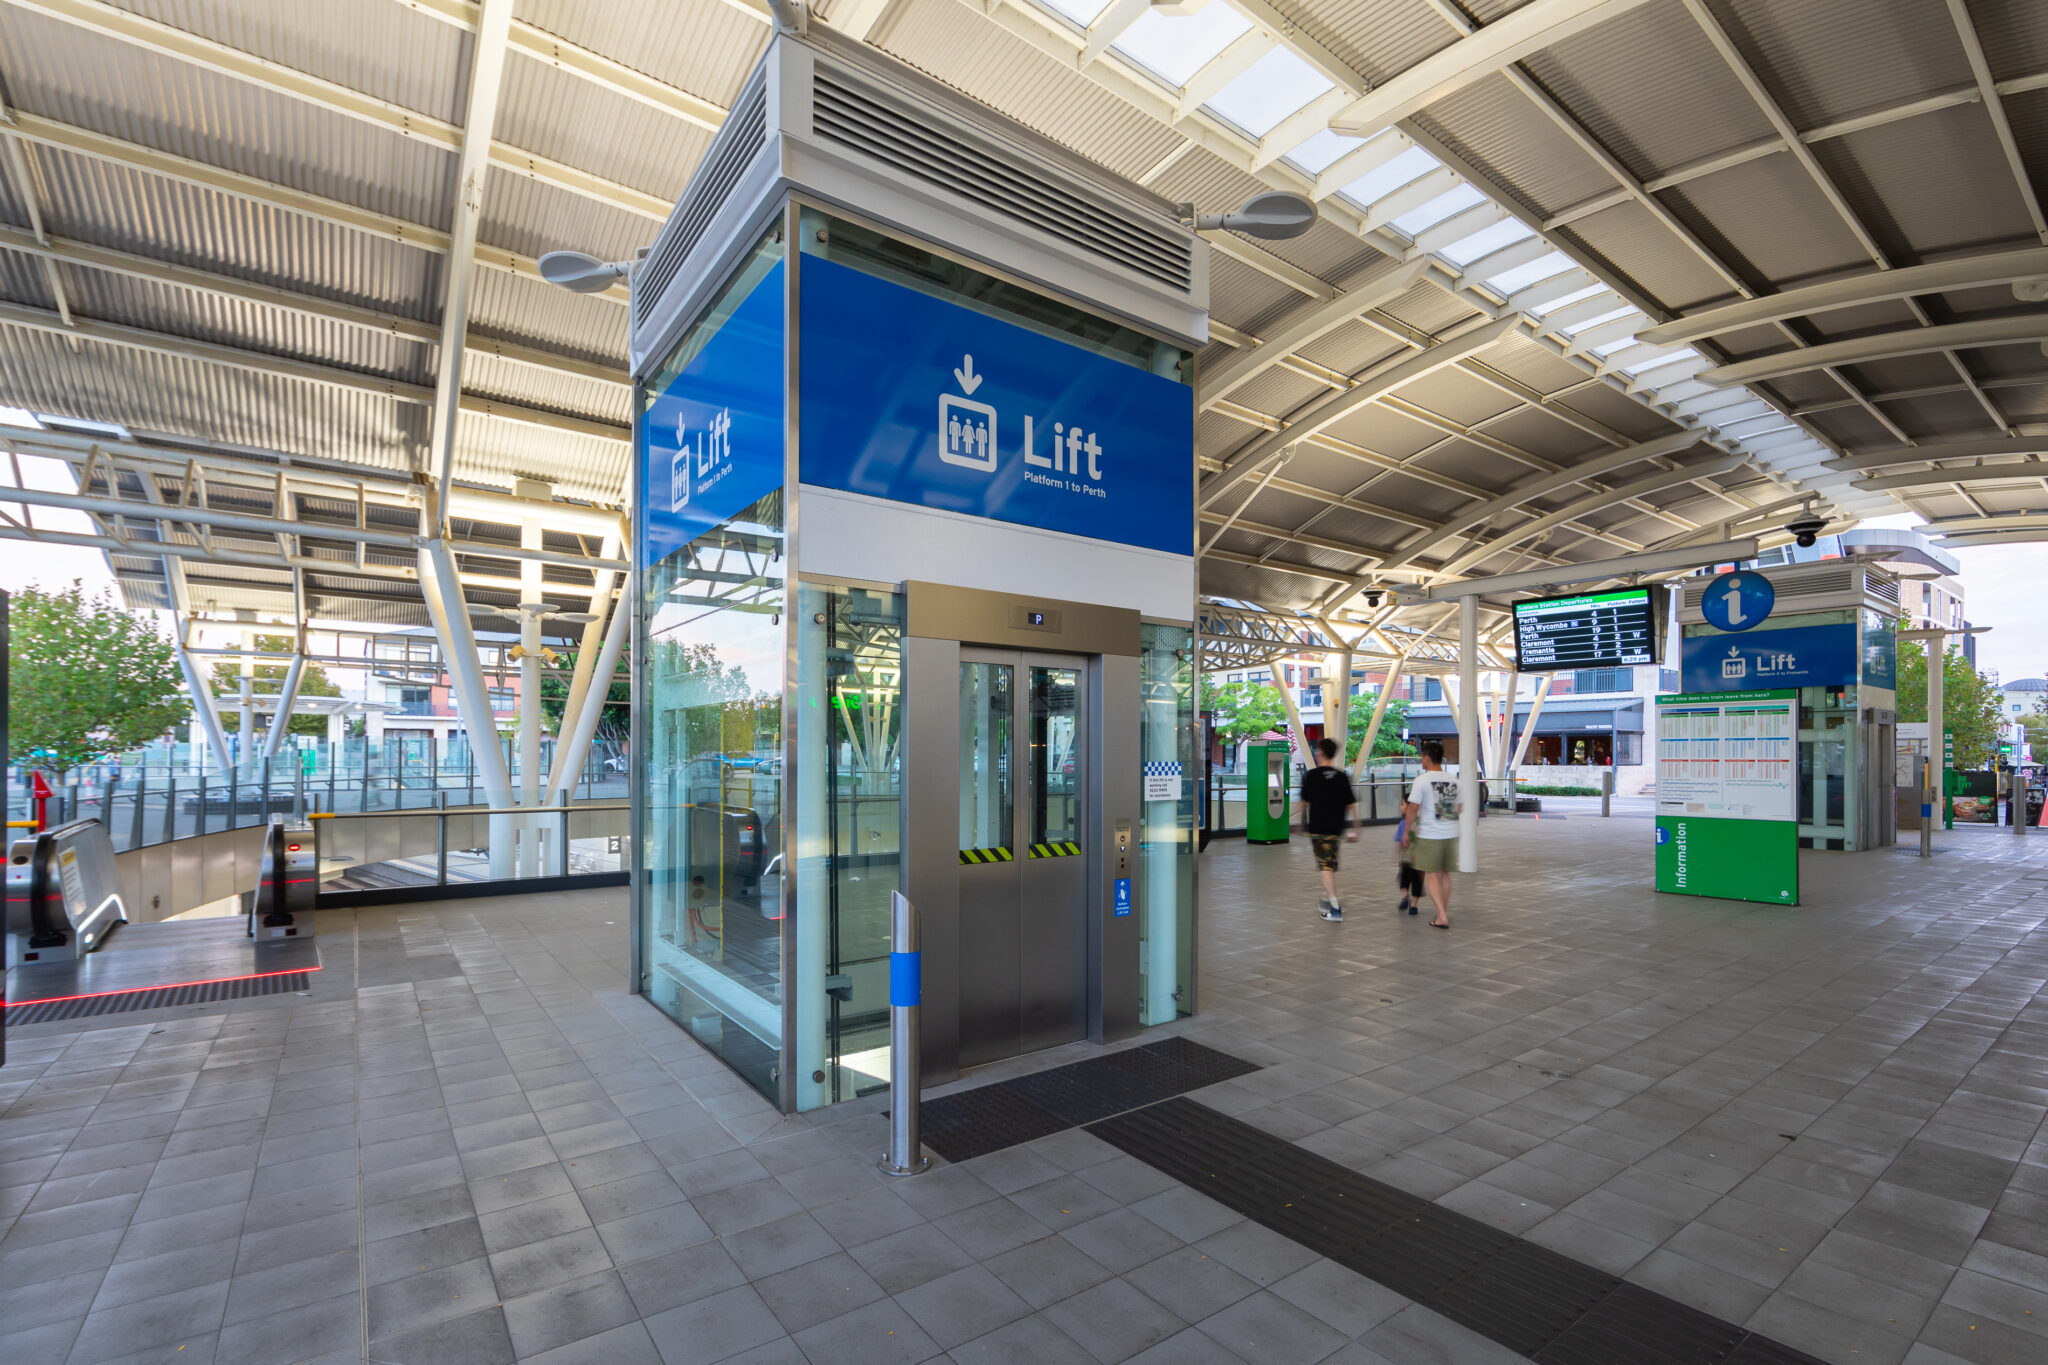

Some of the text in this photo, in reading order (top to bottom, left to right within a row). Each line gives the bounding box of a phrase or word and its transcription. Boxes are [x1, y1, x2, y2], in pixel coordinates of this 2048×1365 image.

[698, 406, 730, 479] Lift
[1024, 415, 1102, 480] Lift
[698, 478, 713, 495] Platform
[716, 472, 721, 482] to
[721, 463, 732, 478] Perth
[1024, 471, 1106, 499] Platform 1 to Perth
[1517, 598, 1593, 611] Subiaco Station Departures
[1035, 614, 1042, 624] P
[1520, 624, 1535, 632] High
[1536, 622, 1568, 632] Wycombe
[1520, 639, 1556, 648] Claremont
[1521, 647, 1556, 656] Fremantle
[1522, 654, 1557, 663] Claremont
[1757, 654, 1796, 671] Lift
[611, 840, 619, 850] 2
[1675, 822, 1687, 888] Information
